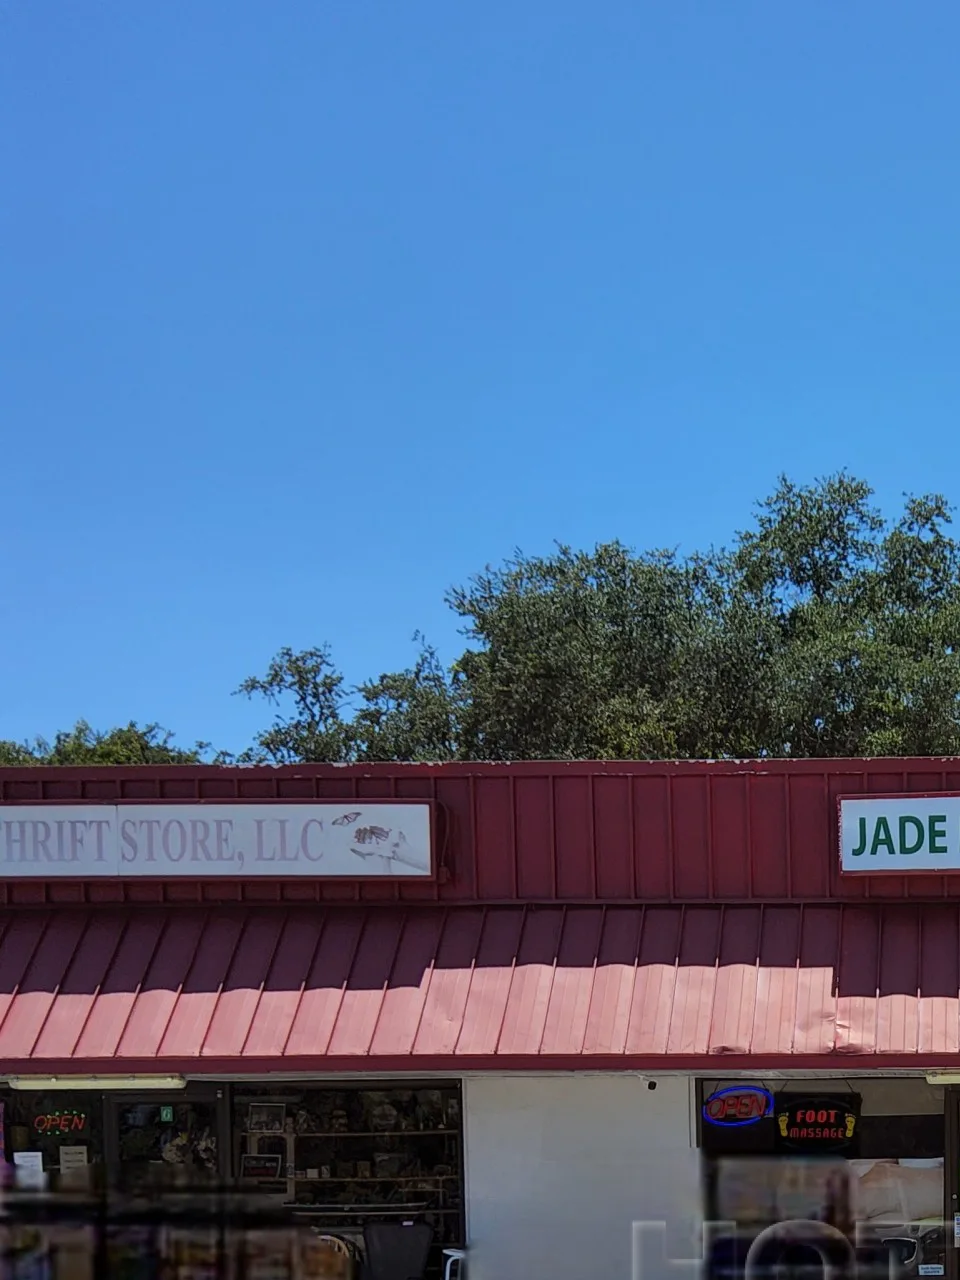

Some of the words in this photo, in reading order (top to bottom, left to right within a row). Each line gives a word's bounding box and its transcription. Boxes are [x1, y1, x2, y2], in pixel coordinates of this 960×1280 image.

[852, 815, 948, 857] JADE
[0, 820, 110, 863] HRIFT
[121, 819, 245, 871] STORE,
[254, 819, 324, 862] LLC
[162, 1107, 172, 1122] 6
[706, 1095, 766, 1118] OPEN
[34, 1114, 86, 1131] OPEN
[796, 1110, 838, 1123] FOOT
[790, 1127, 844, 1139] MASSAGE
